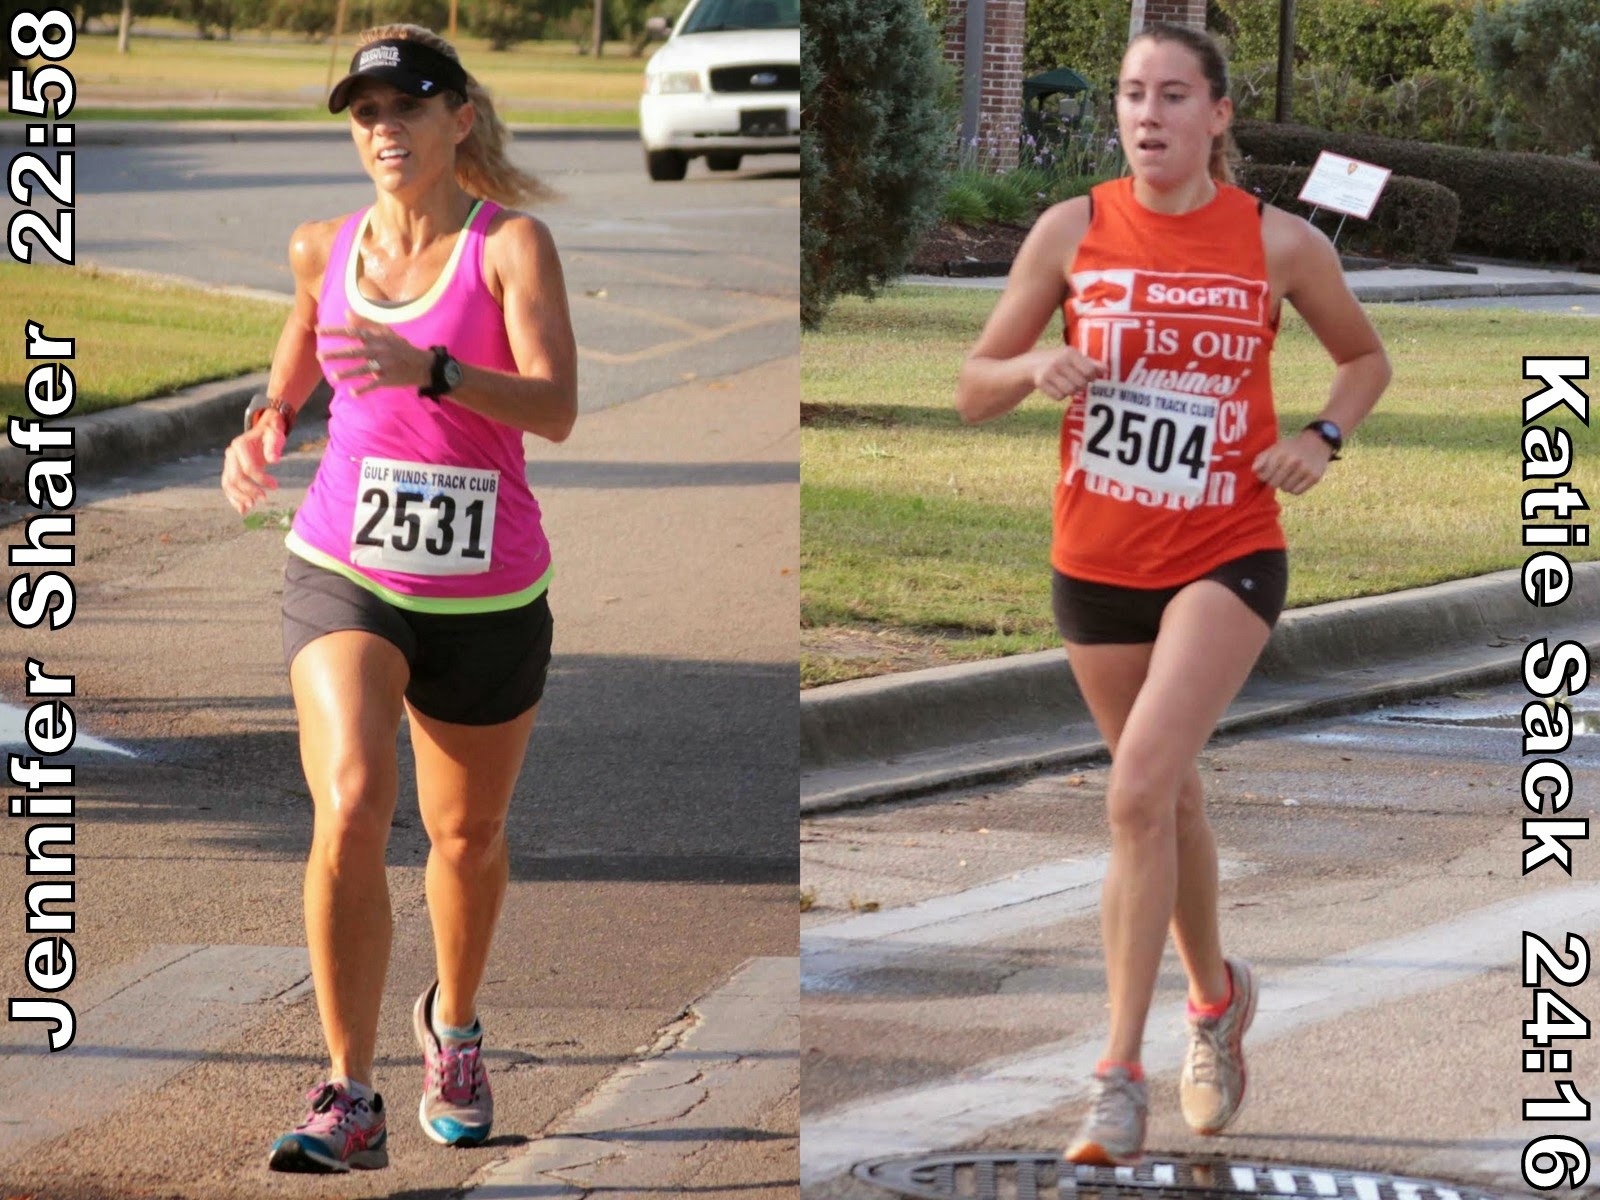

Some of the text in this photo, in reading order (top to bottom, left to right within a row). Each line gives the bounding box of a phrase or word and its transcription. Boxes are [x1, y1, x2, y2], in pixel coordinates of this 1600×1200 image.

[1146, 283, 1249, 310] SOGETI
[1144, 319, 1179, 356] is
[1192, 331, 1262, 363] our
[1090, 385, 1116, 399] GULF
[1154, 396, 1188, 415] TRACK
[1190, 401, 1216, 418] CLUB
[1087, 403, 1207, 479] 2504
[364, 465, 497, 493] GULF WINDS TRACK CLUB
[355, 488, 486, 560] 2531
